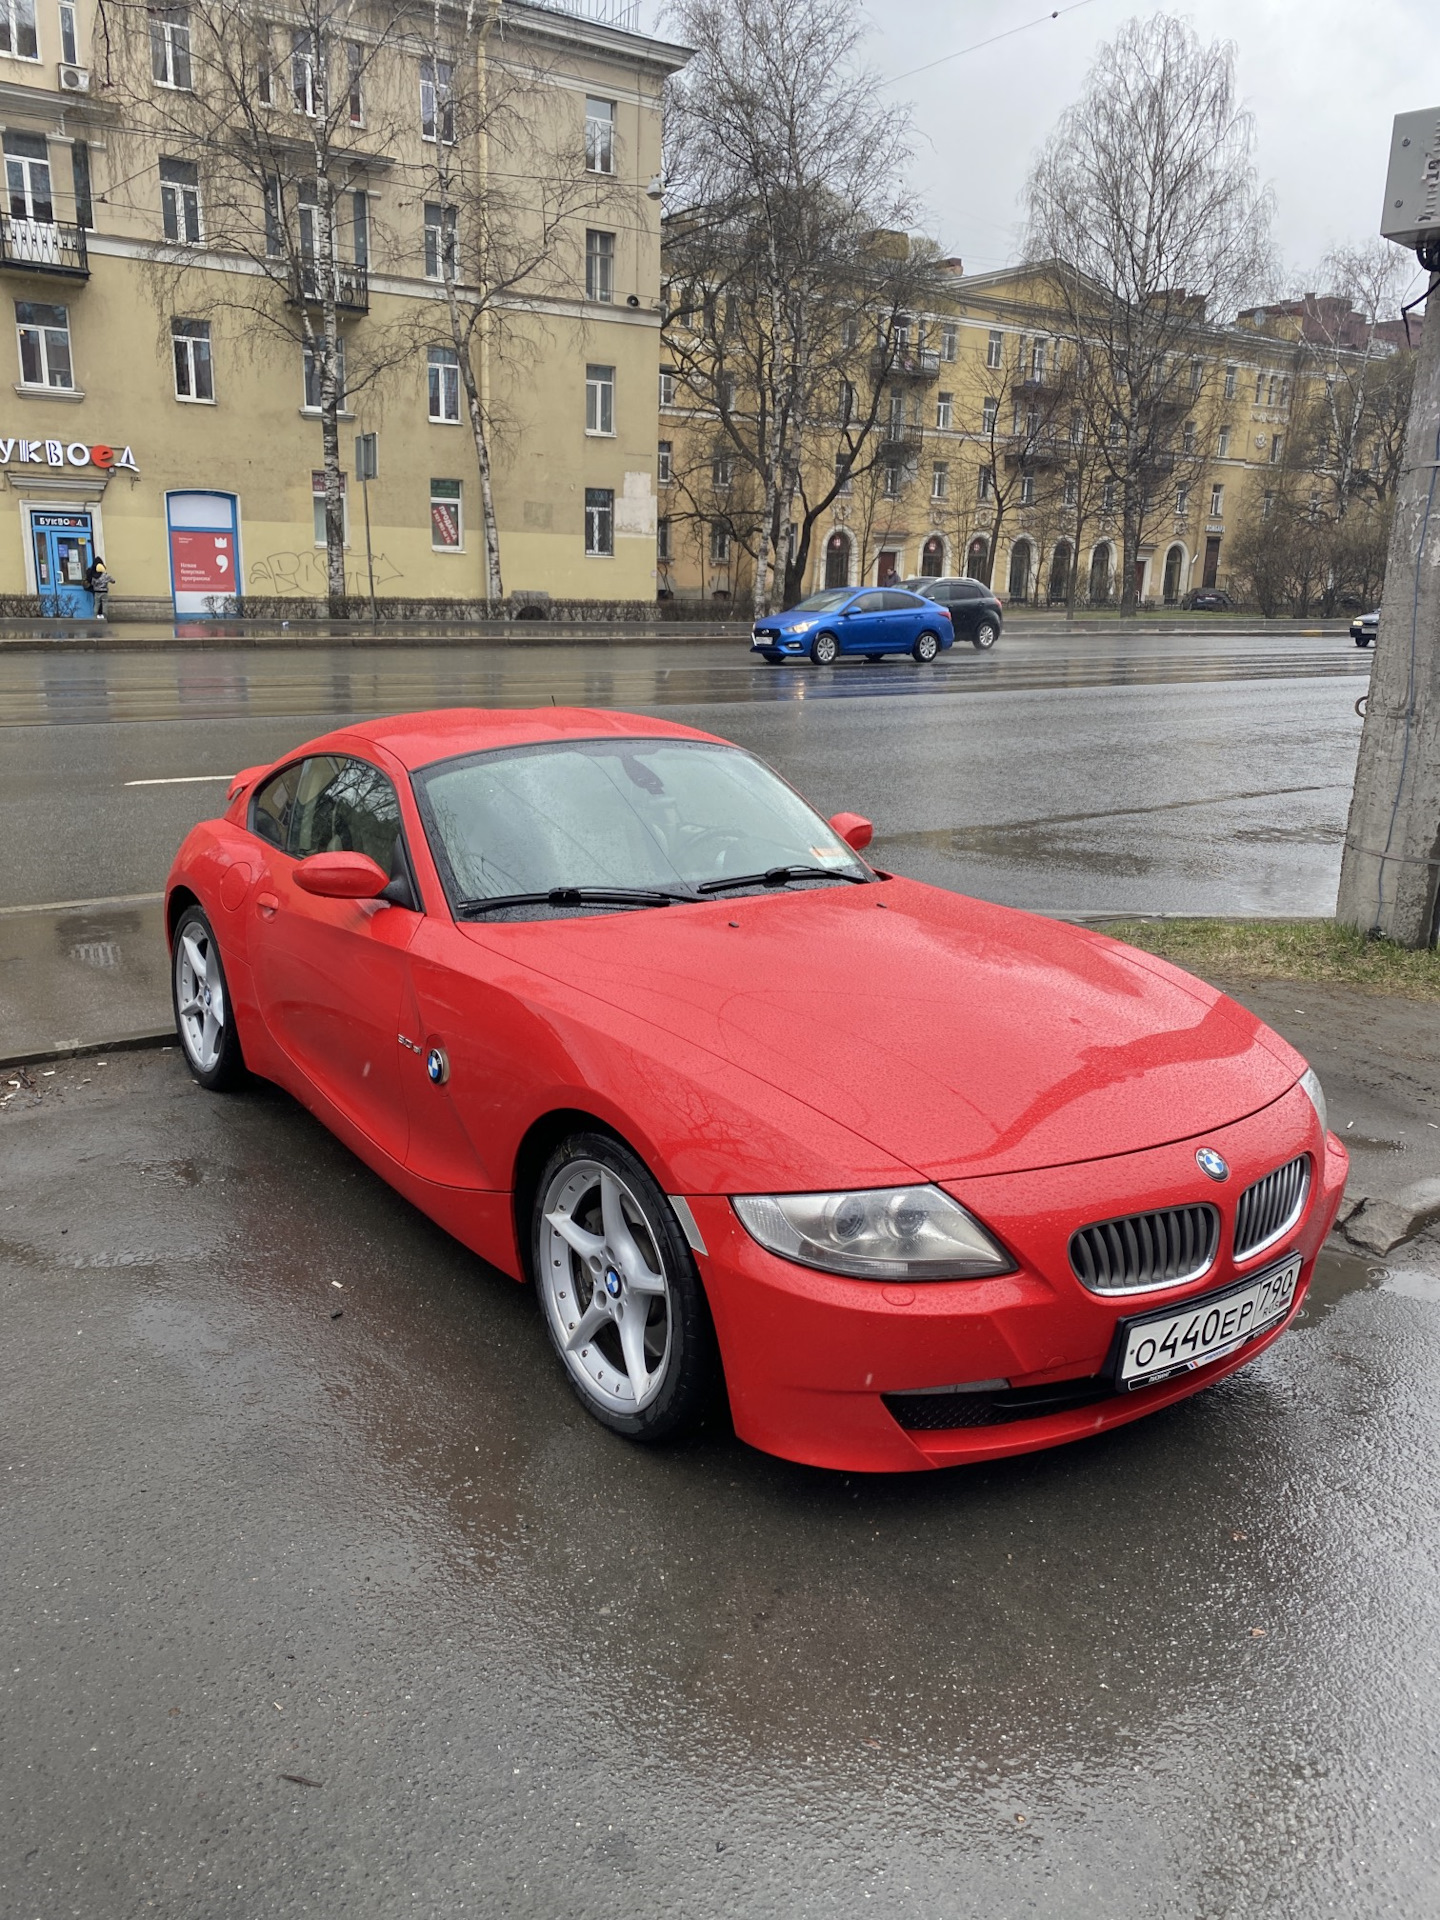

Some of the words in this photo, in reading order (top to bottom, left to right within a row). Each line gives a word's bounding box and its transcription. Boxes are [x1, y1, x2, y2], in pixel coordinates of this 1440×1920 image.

[438, 505, 458, 540] ПРОДАЖА
[1259, 1269, 1293, 1311] 790
[1262, 1302, 1280, 1317] RUS
